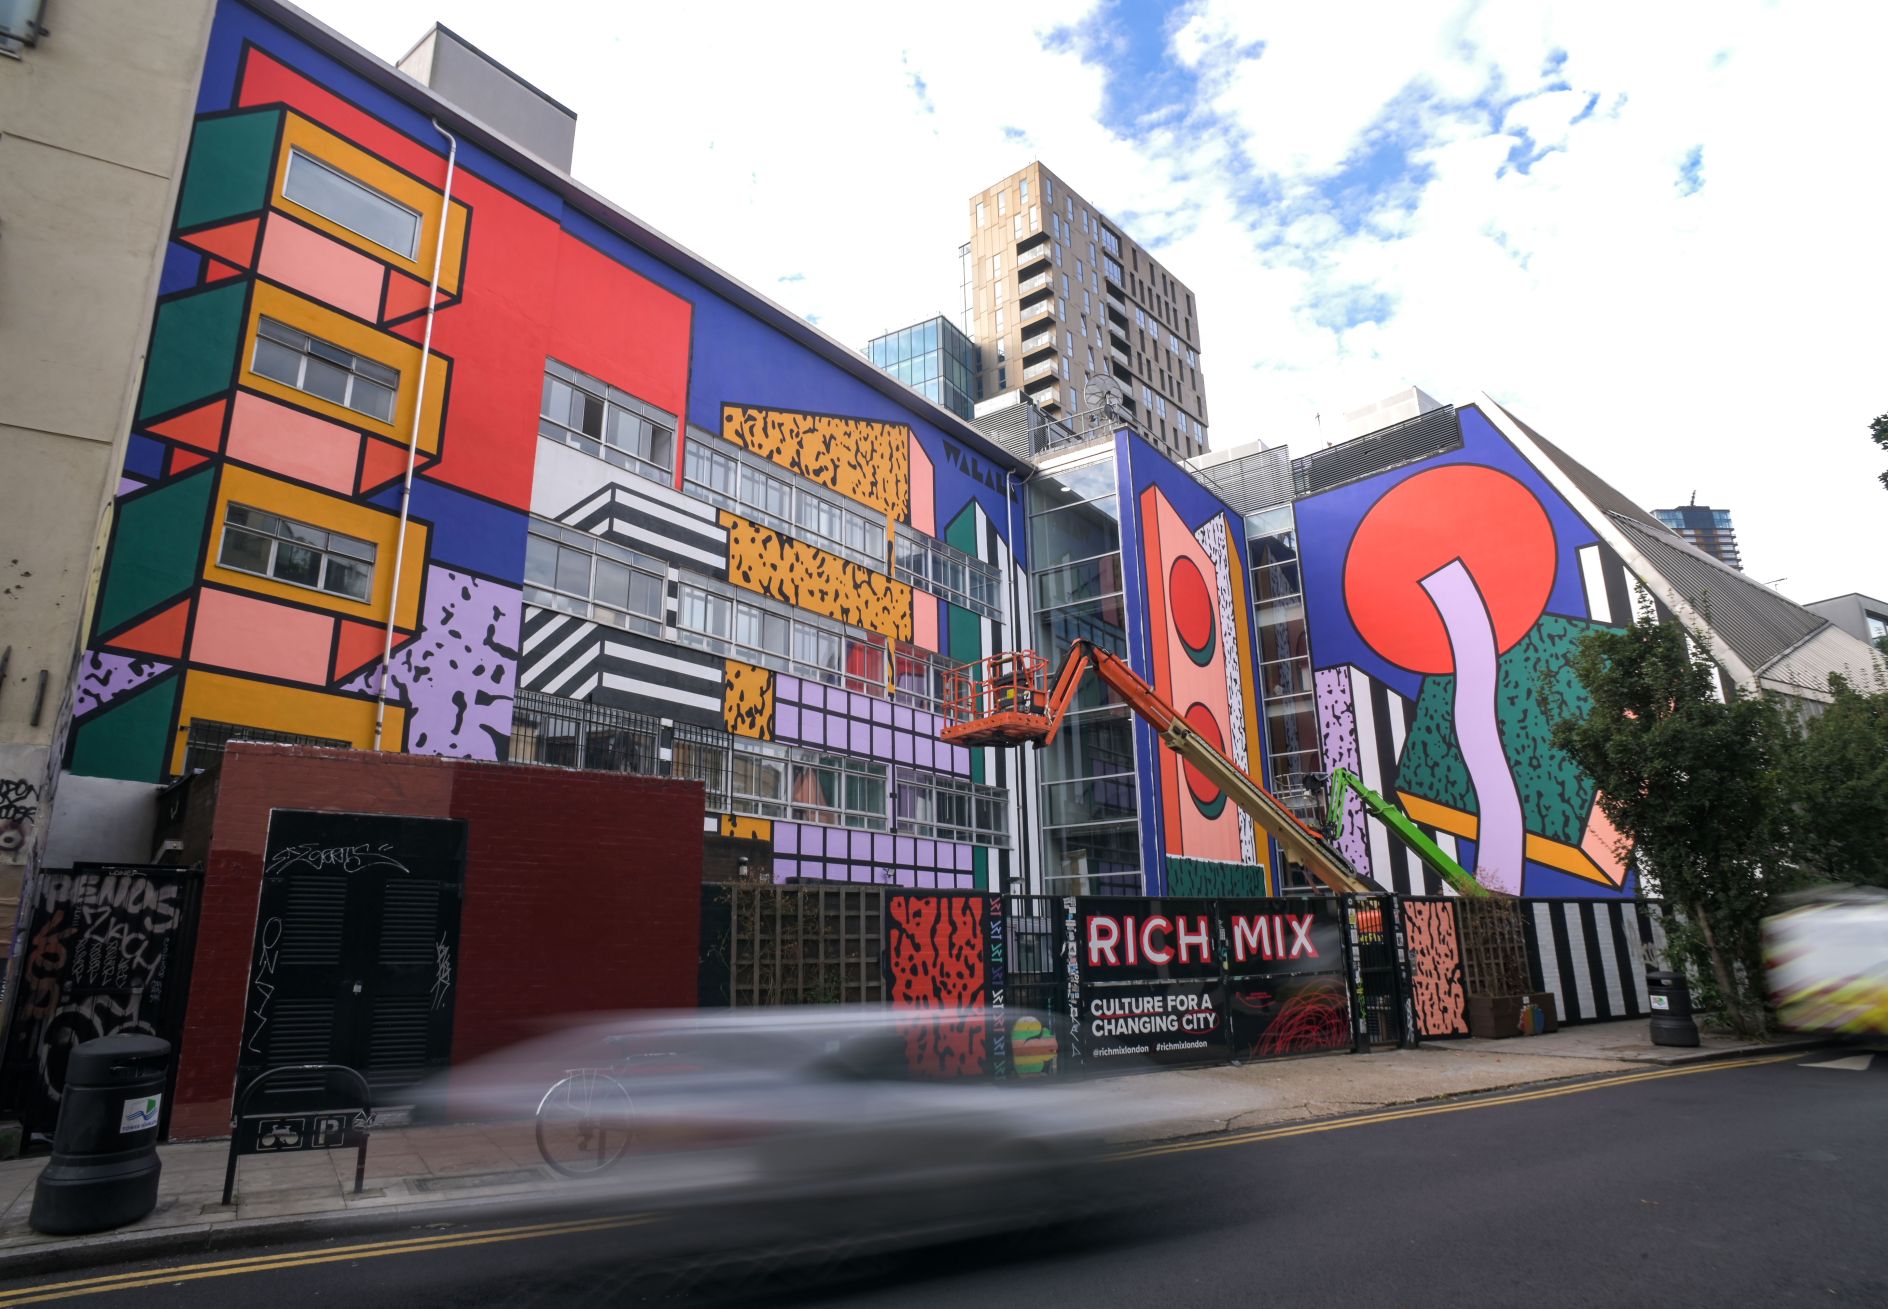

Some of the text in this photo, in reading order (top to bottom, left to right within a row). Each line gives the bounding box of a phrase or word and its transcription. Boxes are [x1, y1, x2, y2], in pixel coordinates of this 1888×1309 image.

[943, 440, 1018, 503] WALALA
[1087, 914, 1319, 966] RICH MIX
[1091, 994, 1213, 1016] CULTURE FOR A
[1092, 1012, 1216, 1037] CHANGING CITY
[1093, 1040, 1208, 1058] @richmixlondon #richmixlondon
[318, 1119, 340, 1145] P
